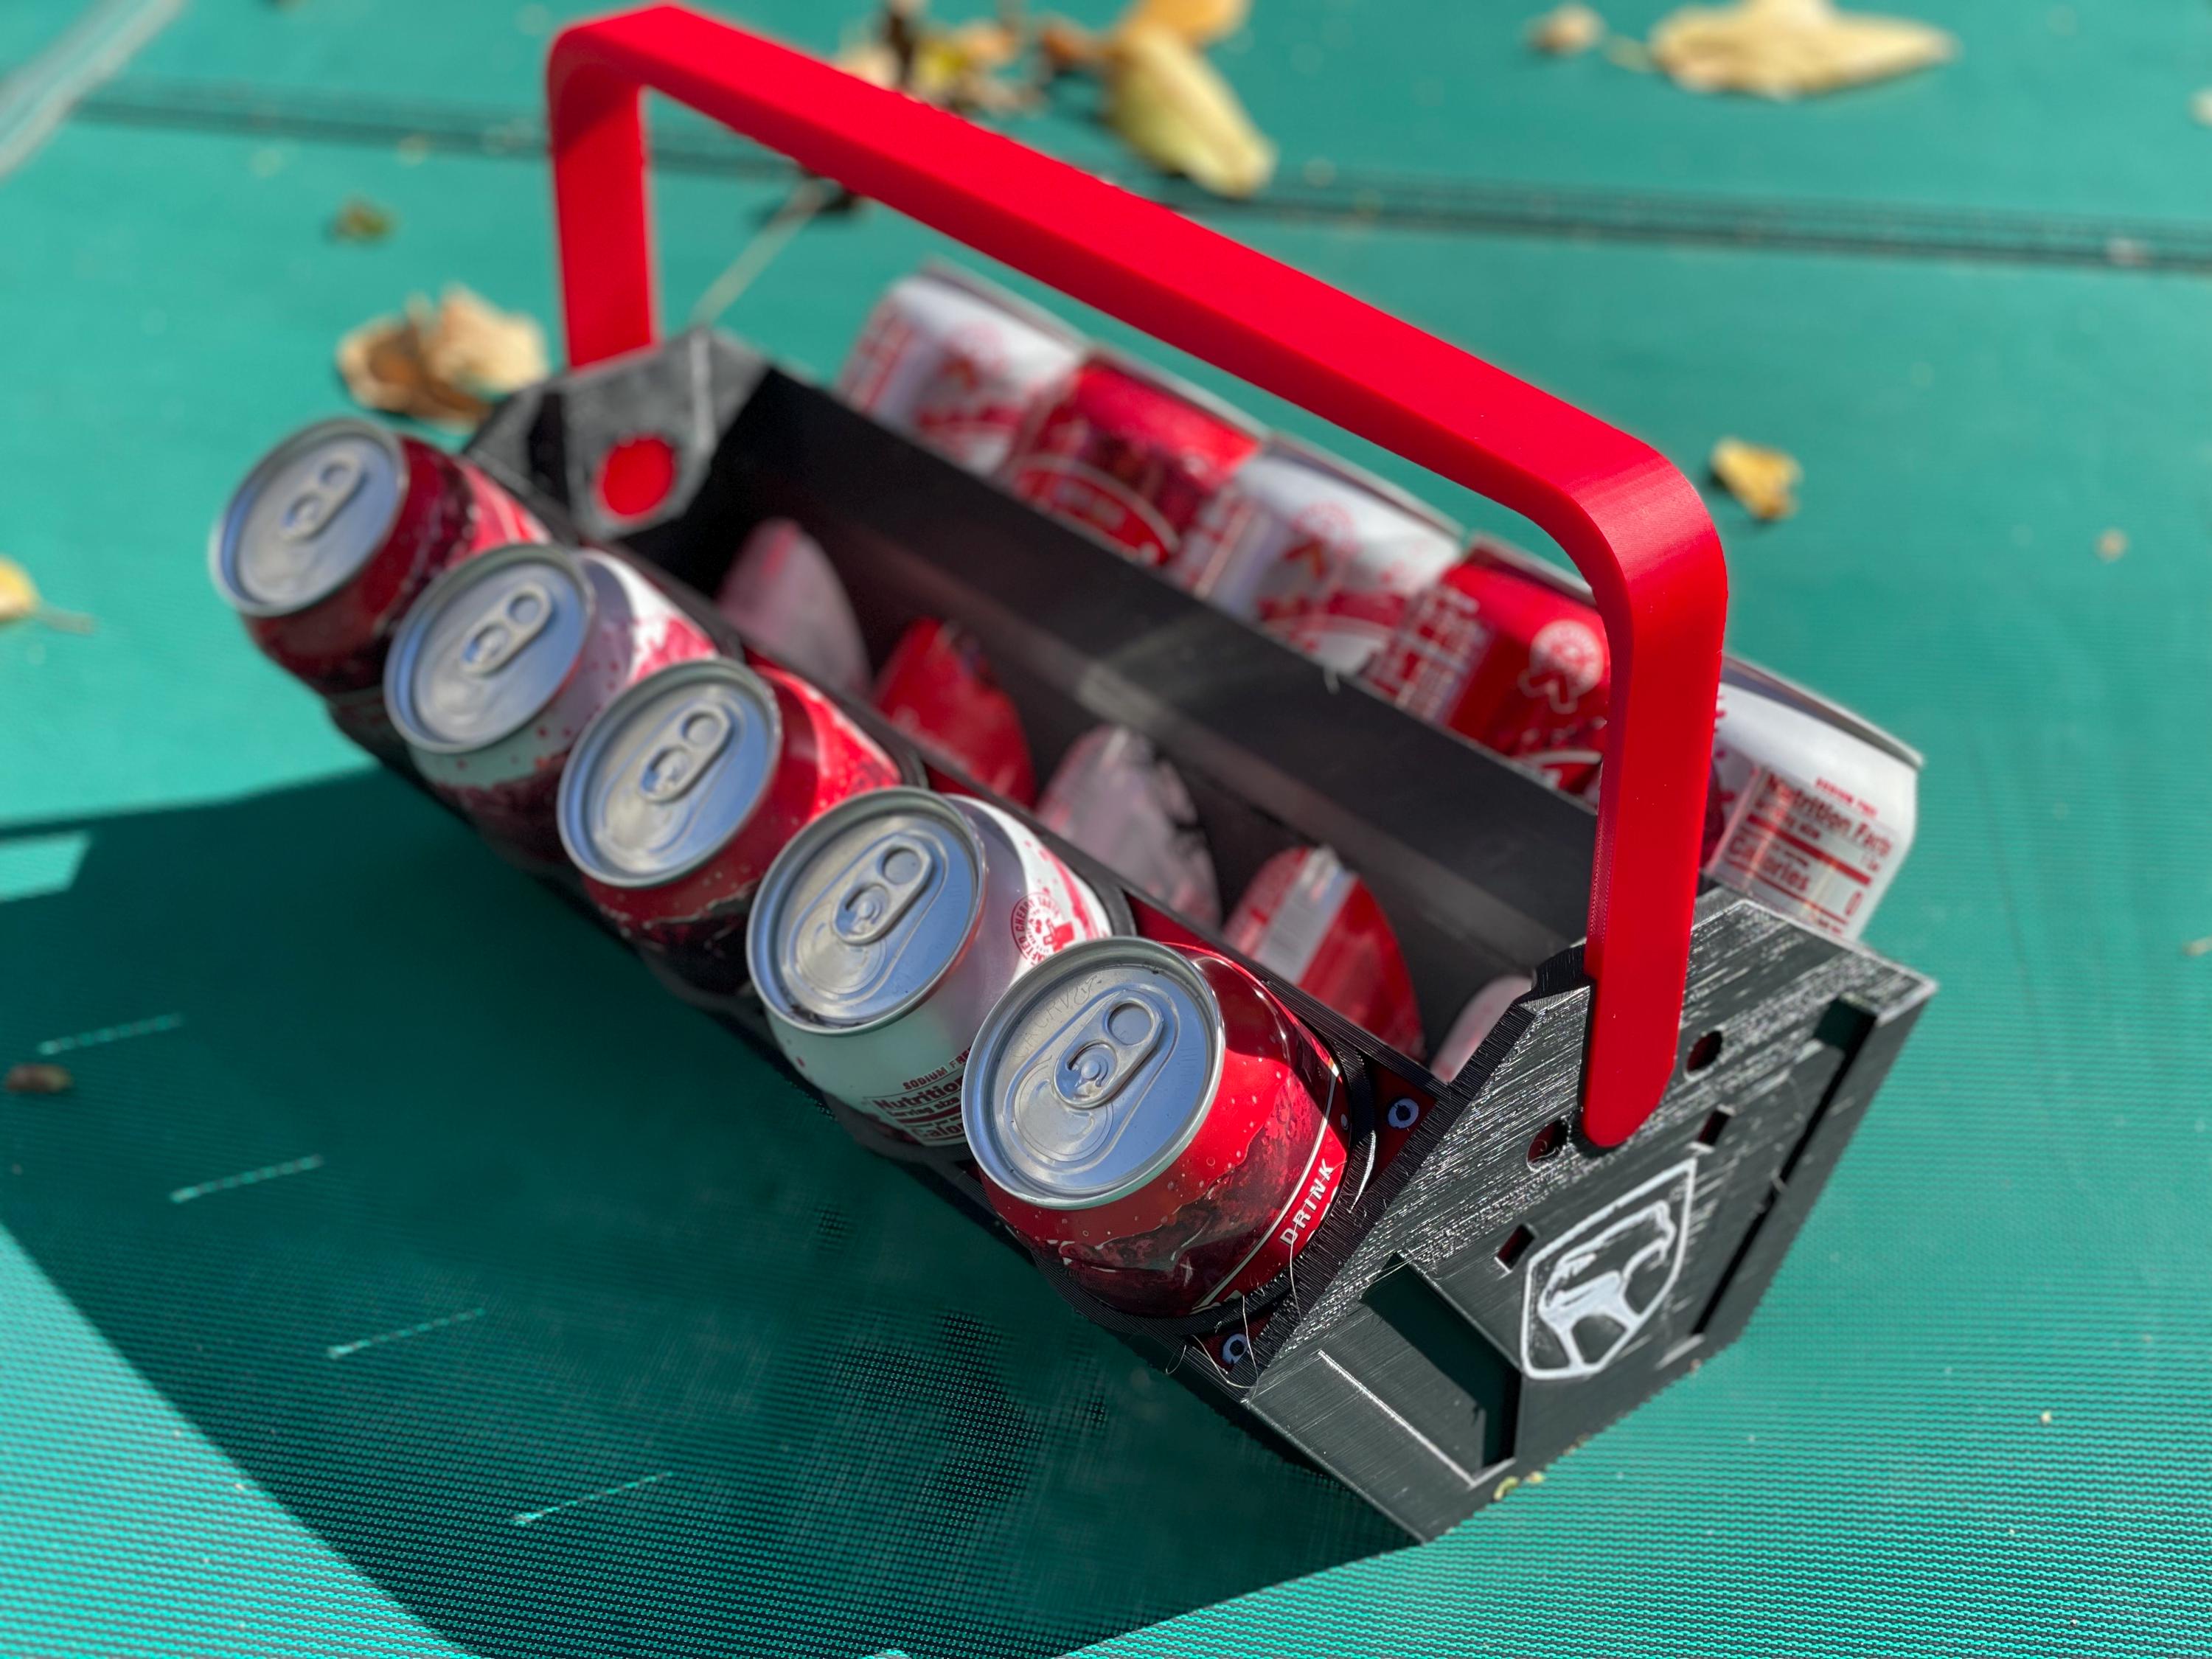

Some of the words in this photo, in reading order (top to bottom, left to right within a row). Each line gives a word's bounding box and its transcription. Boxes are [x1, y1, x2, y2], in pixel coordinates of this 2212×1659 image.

[1015, 898, 1034, 932] CHERRY
[902, 1066, 947, 1091] SODIUM
[950, 1046, 972, 1068] FRE
[911, 1121, 963, 1138] Calo
[1280, 1158, 1334, 1246] DRINK
